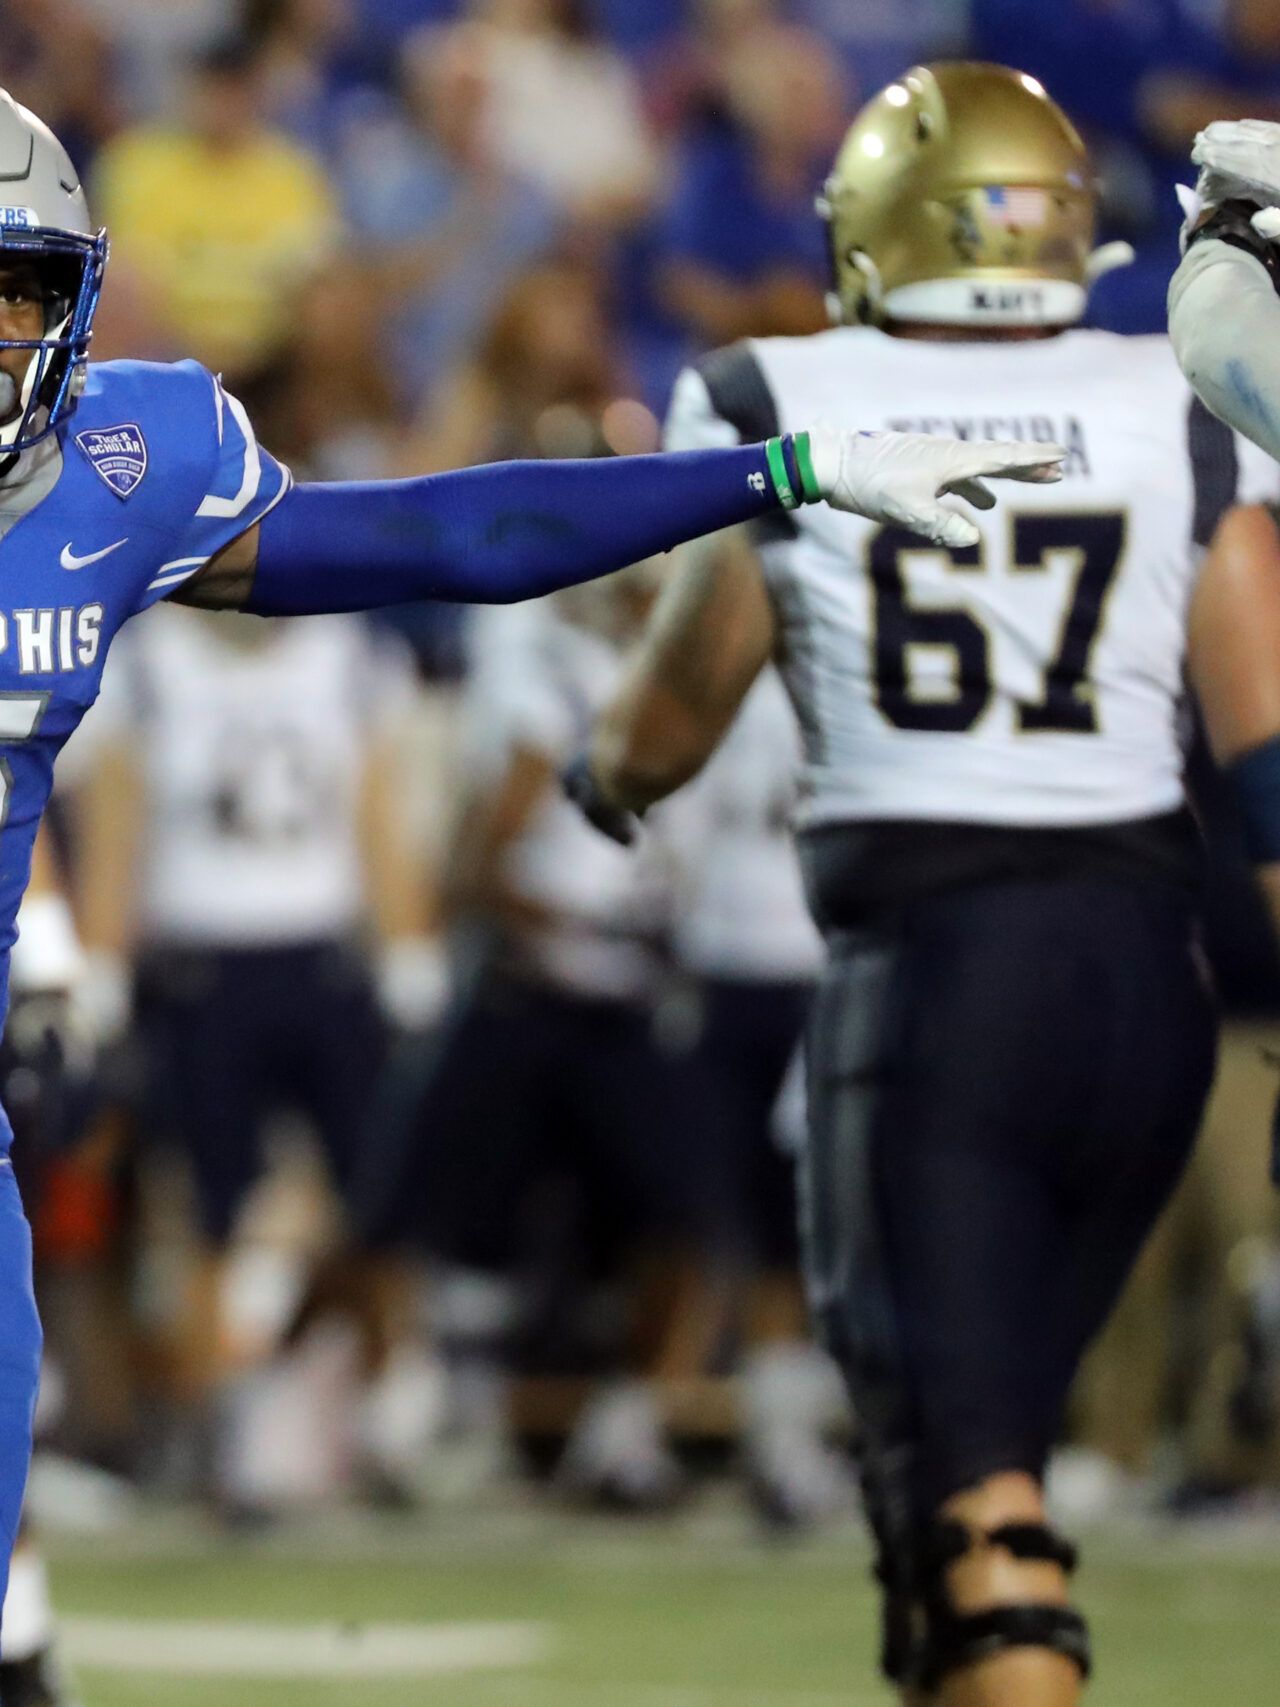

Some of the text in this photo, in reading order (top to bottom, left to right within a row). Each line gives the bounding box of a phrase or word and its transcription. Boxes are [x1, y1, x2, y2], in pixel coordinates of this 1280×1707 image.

[89, 431, 132, 445] TIGER
[87, 440, 142, 456] SCHOLAR
[866, 505, 1130, 736] 67
